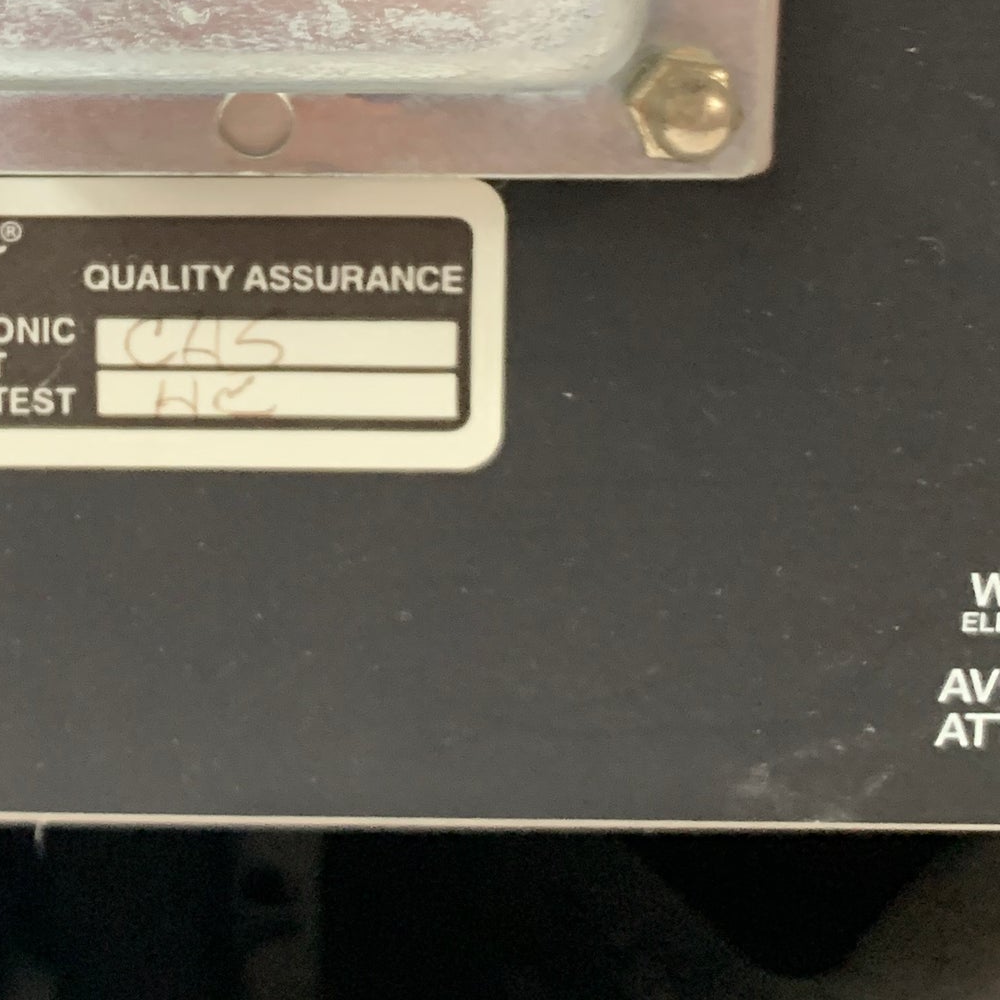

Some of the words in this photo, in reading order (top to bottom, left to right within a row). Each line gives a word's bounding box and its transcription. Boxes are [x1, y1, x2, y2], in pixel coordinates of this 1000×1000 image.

[83, 263, 235, 293] QUALITY
[243, 264, 464, 295] ASSURANCE
[960, 611, 1000, 634] EL
[933, 712, 1000, 749] AT
